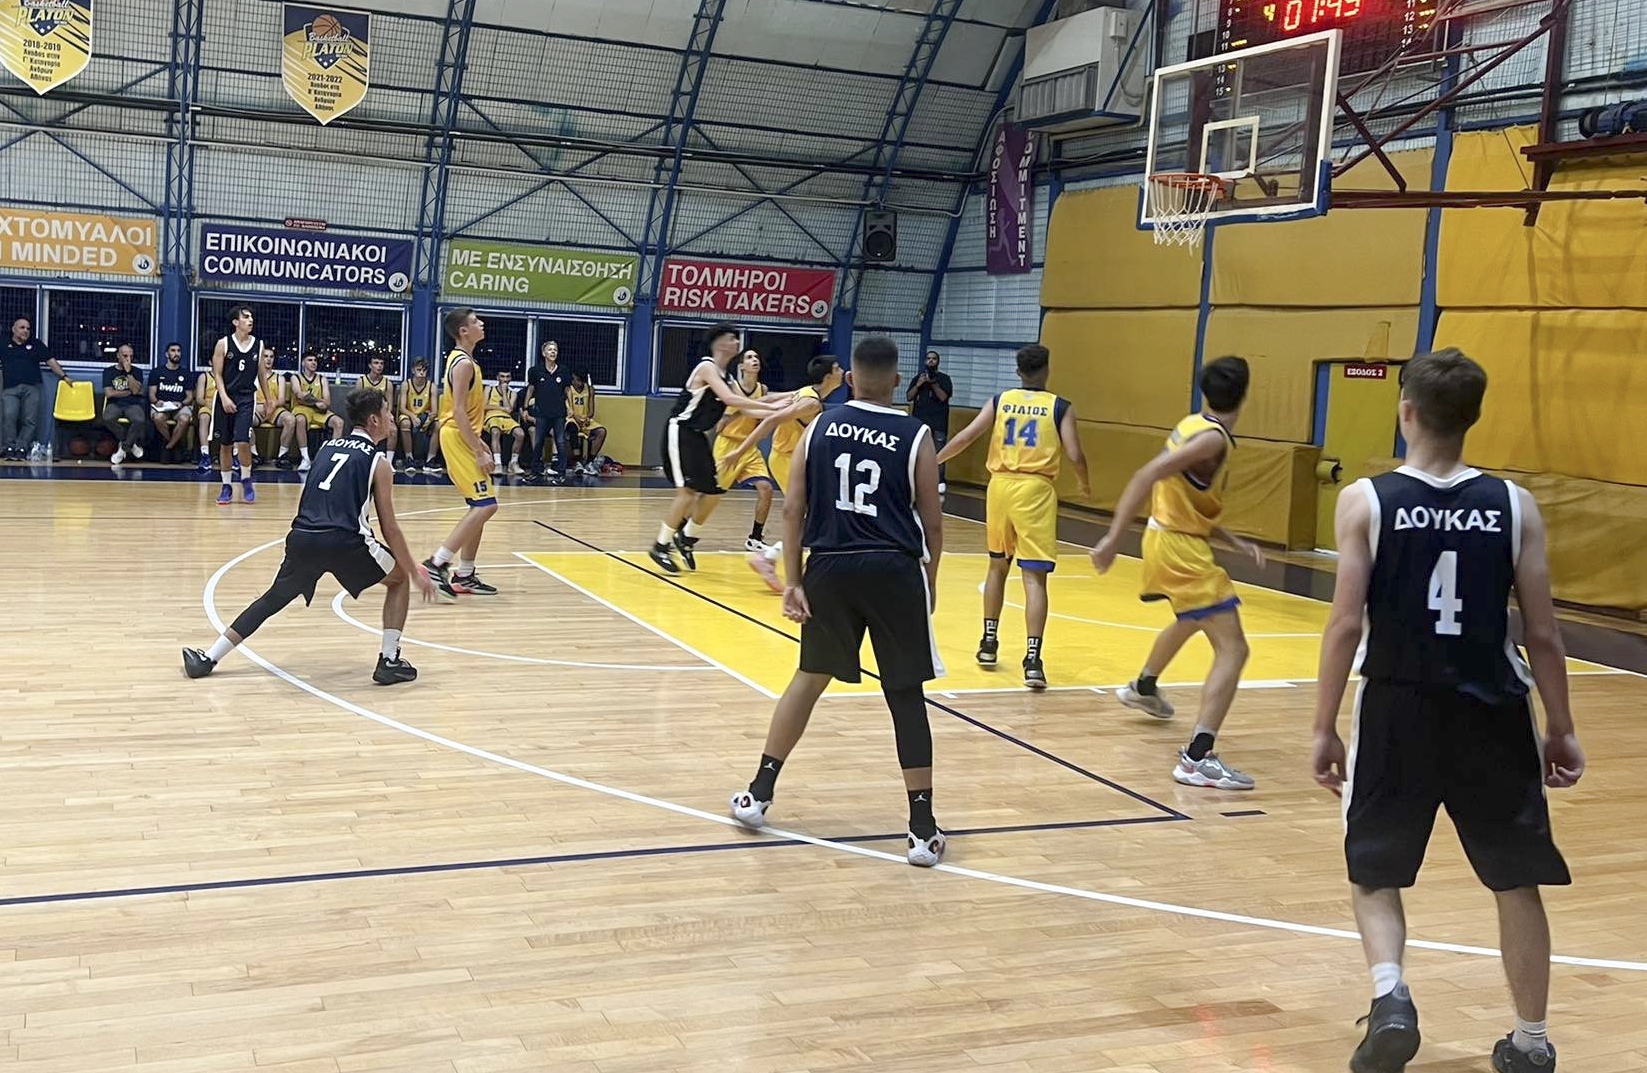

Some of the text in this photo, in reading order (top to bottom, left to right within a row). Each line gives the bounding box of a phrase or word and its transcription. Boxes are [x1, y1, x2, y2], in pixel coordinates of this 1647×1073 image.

[16, 7, 74, 27] PLATON
[1226, 19, 1232, 28] 9
[1404, 11, 1415, 21] 12
[1222, 30, 1230, 39] 10
[1403, 24, 1413, 35] 13
[23, 39, 61, 52] 2018-2019
[301, 41, 354, 60] PLATON
[1221, 42, 1228, 51] 11
[307, 73, 343, 84] 2021-2022
[1215, 86, 1224, 96] 15
[11, 241, 118, 267] MINDED
[205, 232, 387, 263] ΕΠΙΚΟΙΝΩΝΙΑΚΟΙ
[204, 255, 386, 285] COMMUNICATORS
[451, 249, 633, 280] ΜΕ ΕΝΣΥΝΑΙΣΘΗΣΗ
[449, 271, 530, 293] CARING
[668, 264, 787, 291] ΤΟΛΜΗΡΟΙ
[663, 287, 811, 314] RISK TAKERS
[238, 359, 246, 371] 6
[1347, 368, 1383, 377] ΕΞΟΔΟΣ 2
[159, 382, 184, 393] bwin
[1002, 404, 1048, 416] ΦΙΛΙΟΣ
[825, 421, 900, 452] ΔΟΥΚΑΣ
[1003, 416, 1038, 447] 14
[326, 438, 375, 456] ΔΟΥΚΑΣ
[318, 452, 350, 491] 7
[473, 480, 487, 493] 15
[834, 452, 881, 517] 12
[1394, 505, 1502, 532] ΔΟΥΚΑΣ
[1427, 550, 1463, 636] 4
